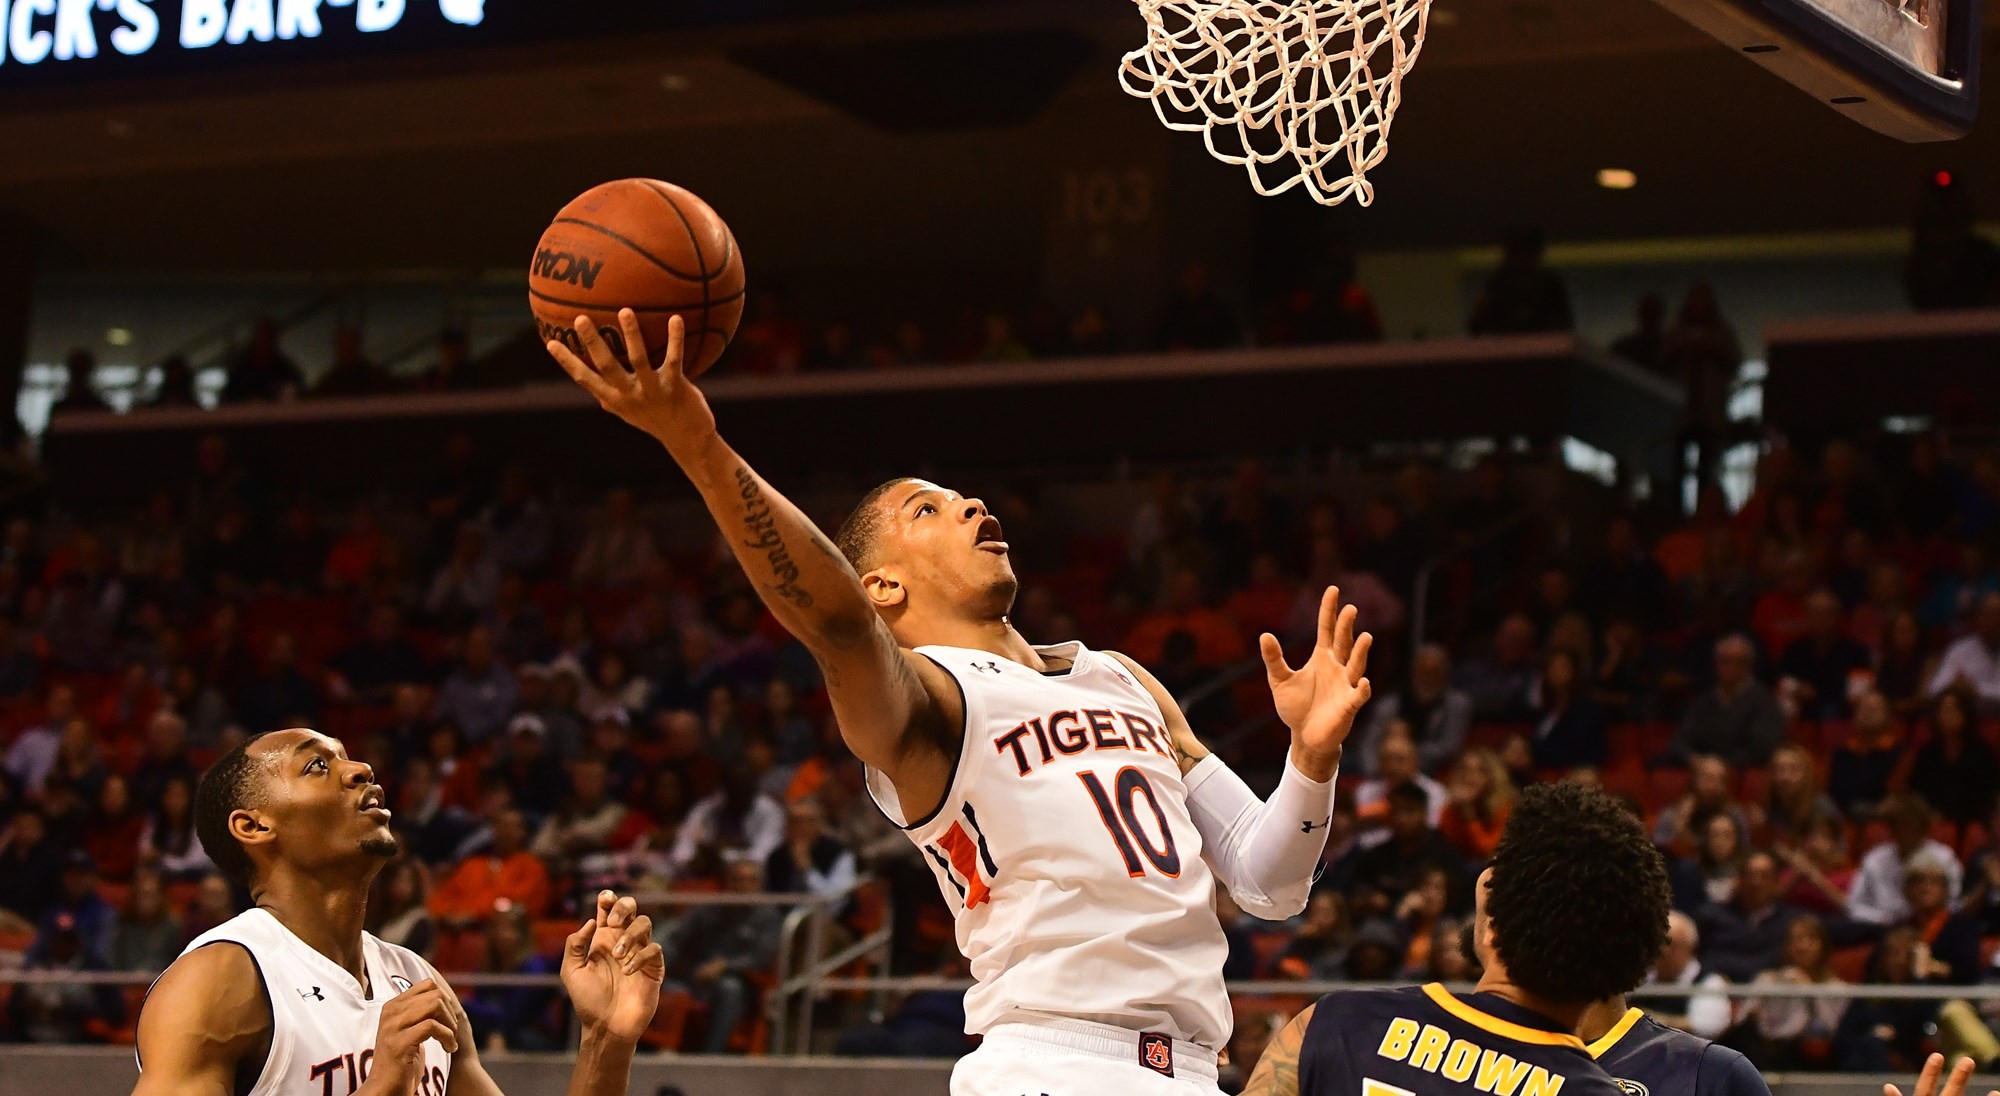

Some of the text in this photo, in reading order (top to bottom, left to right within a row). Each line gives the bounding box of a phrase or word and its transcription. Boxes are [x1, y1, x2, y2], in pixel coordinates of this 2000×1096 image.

[1064, 167, 1152, 223] 103
[533, 248, 604, 290] NCAA
[1076, 765, 1181, 879] 10
[1377, 1017, 1566, 1096] BROWN
